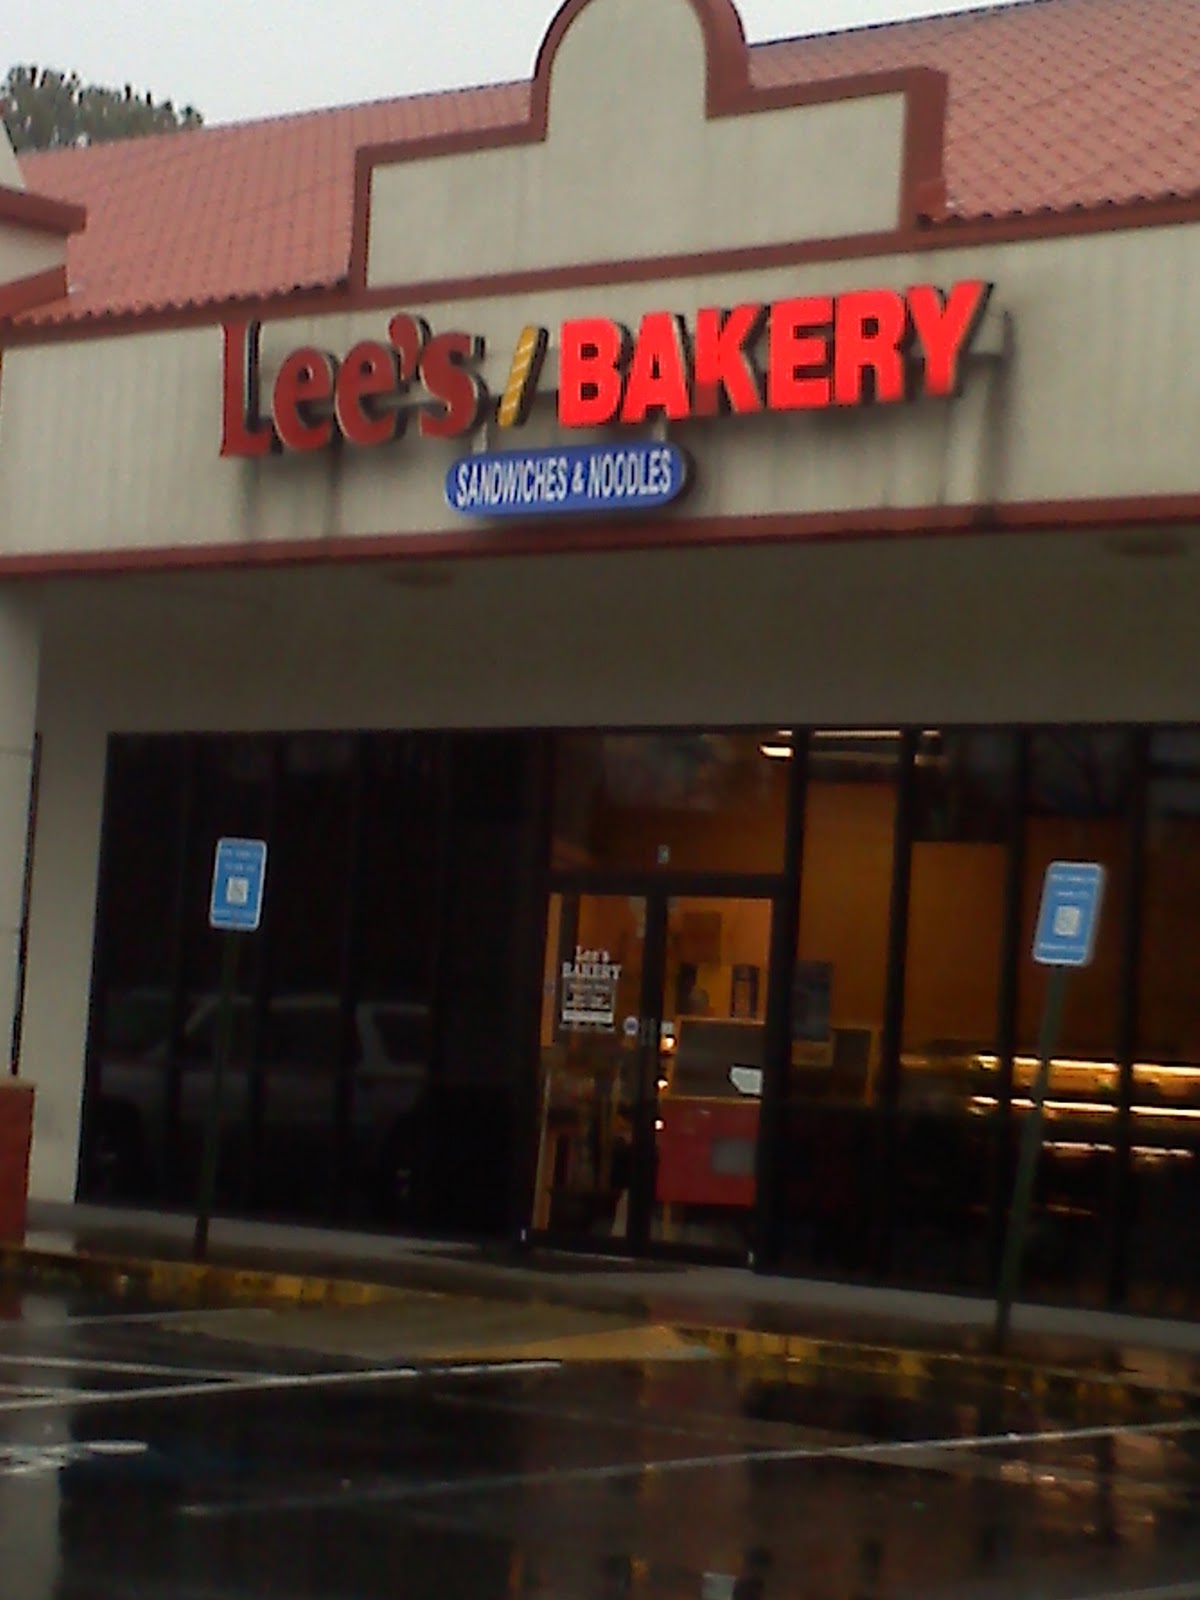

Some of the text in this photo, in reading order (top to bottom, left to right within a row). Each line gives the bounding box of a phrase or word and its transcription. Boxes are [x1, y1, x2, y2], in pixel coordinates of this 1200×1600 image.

[220, 279, 986, 458] Lee's BAKERY
[456, 449, 672, 507] SANDWICHES & NOODLES
